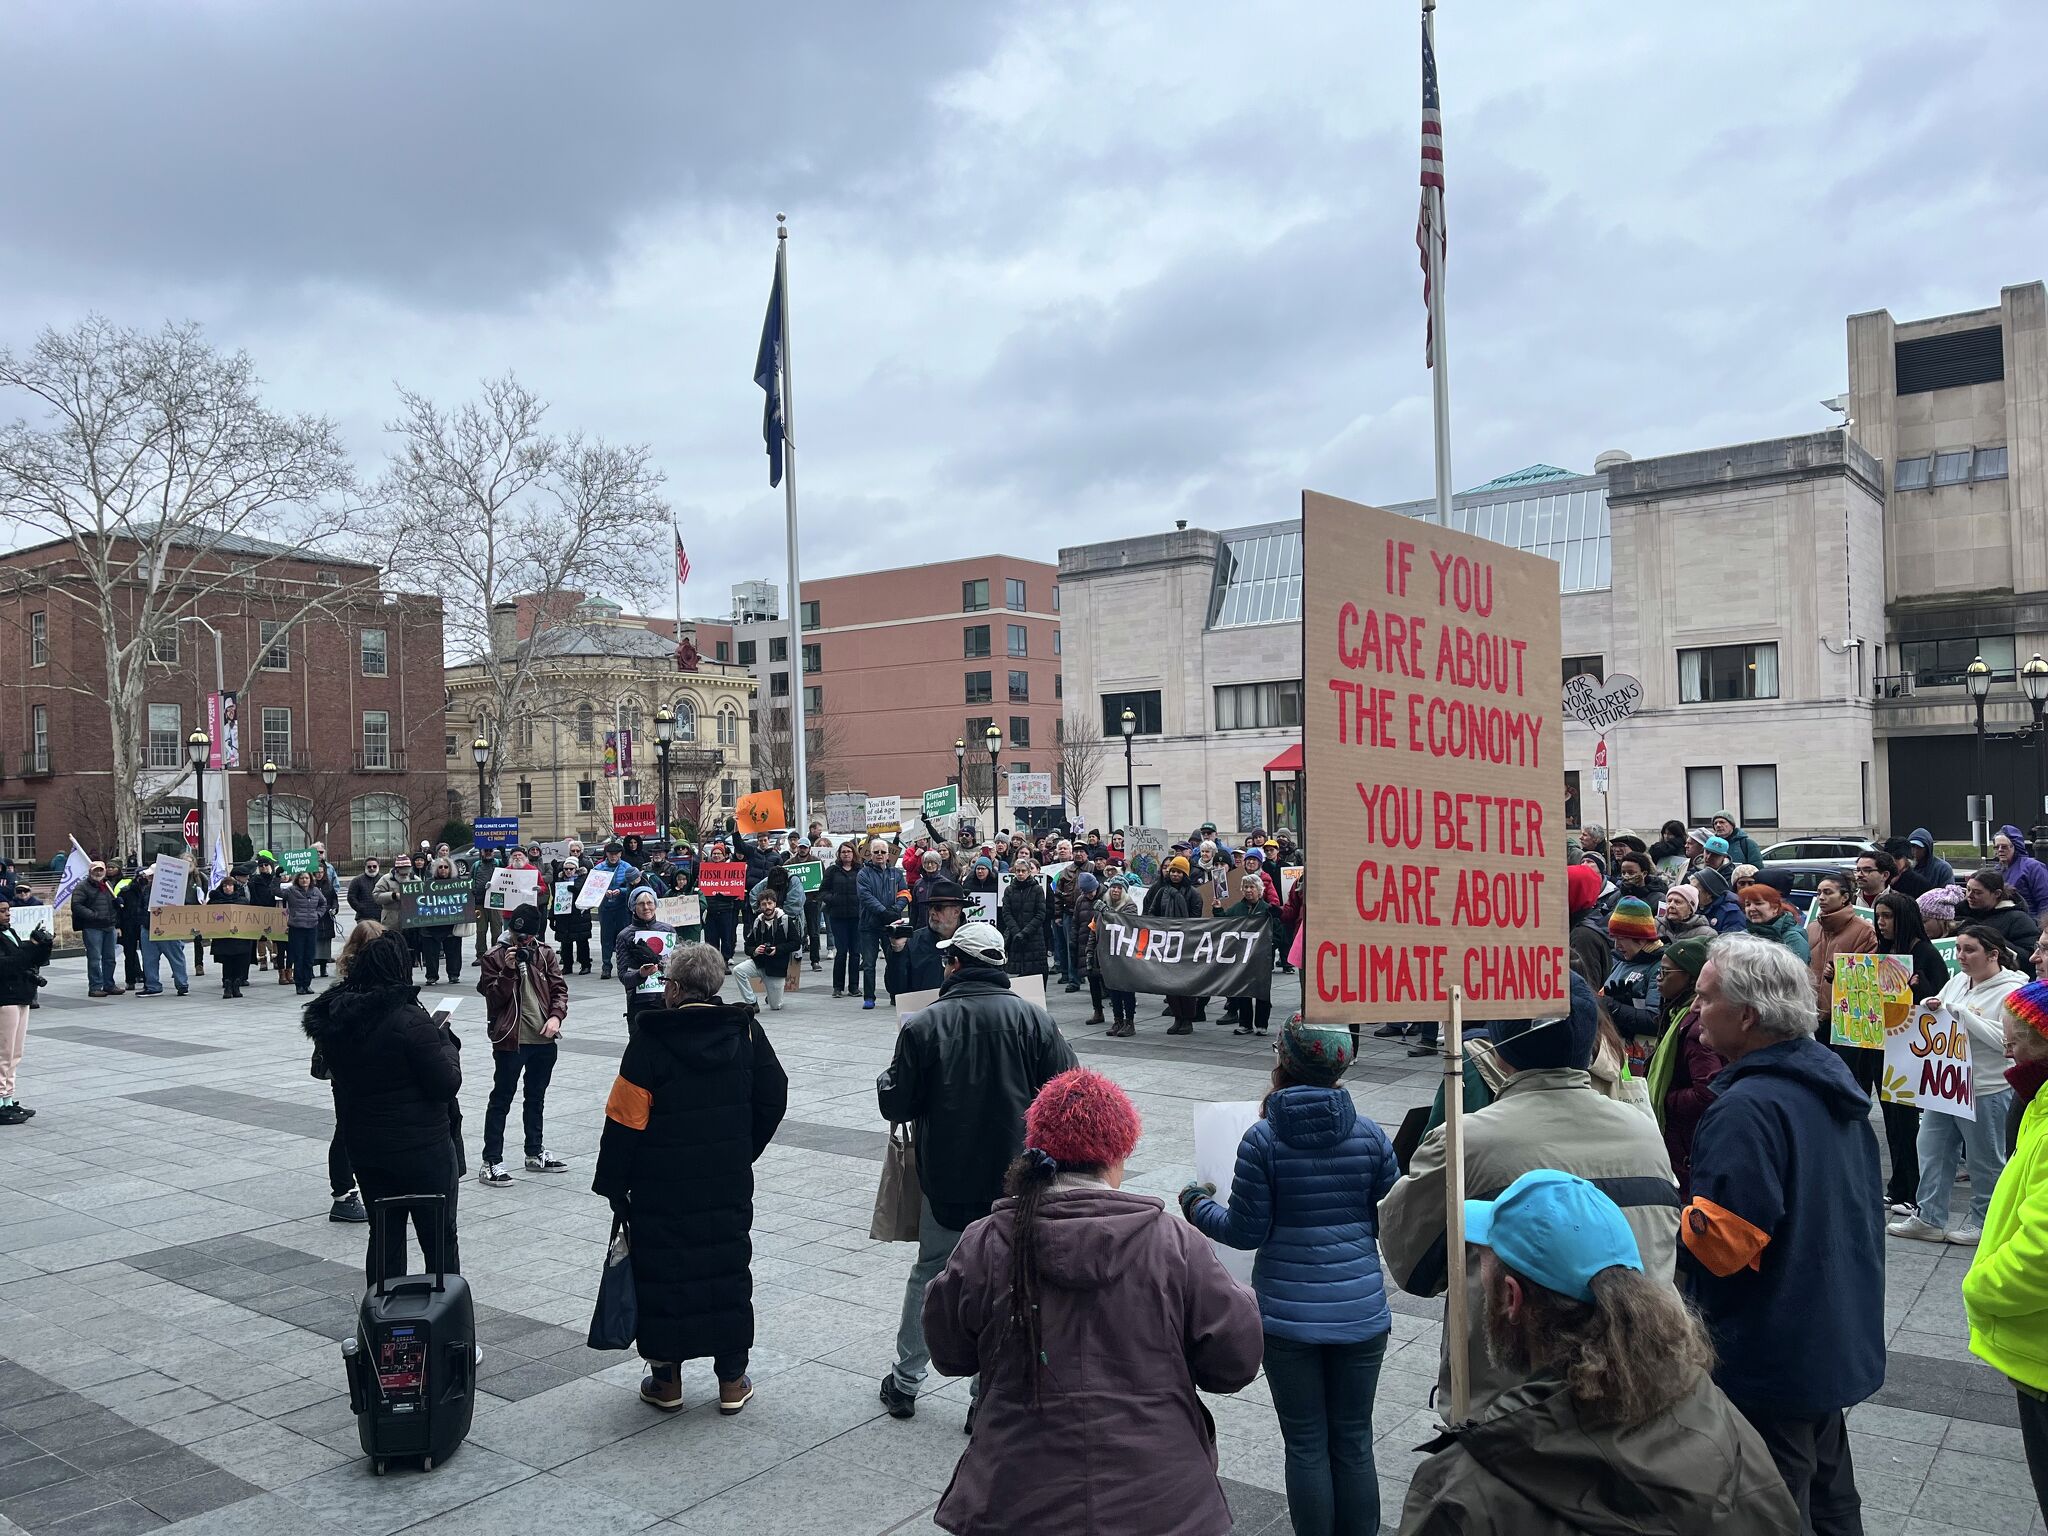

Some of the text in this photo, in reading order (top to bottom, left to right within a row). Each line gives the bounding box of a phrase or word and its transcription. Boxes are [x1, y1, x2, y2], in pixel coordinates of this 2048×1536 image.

[1386, 539, 1493, 618] IF YOU
[1338, 601, 1527, 697] CARE ABOUT
[1566, 676, 1590, 695] FOR
[1563, 688, 1596, 710] YOUR
[1576, 684, 1639, 721] CHILDREN'S
[1588, 701, 1633, 730] FUTURE
[1329, 679, 1543, 769] THE ECONOMY
[926, 790, 949, 800] Climate
[868, 801, 885, 809] You'll
[926, 799, 945, 809] Action
[614, 810, 656, 821] FOSSIL FUELS
[1356, 782, 1545, 858] YOU BETTER
[185, 822, 199, 836] STO
[1129, 827, 1151, 837] SAVE
[1136, 836, 1160, 844] YOUR
[284, 851, 312, 860] Climate
[287, 859, 310, 867] Action
[700, 869, 745, 879] FOSSIL FUELS
[402, 881, 425, 894] KEEP
[1355, 860, 1545, 929] CARE ABOUT
[416, 893, 468, 906] CLIMATE
[159, 911, 200, 926] LATER
[222, 911, 243, 923] NOT
[245, 912, 260, 925] AN
[1193, 931, 1260, 964] ACT
[1316, 940, 1565, 1003] CLIMATE CHANGE
